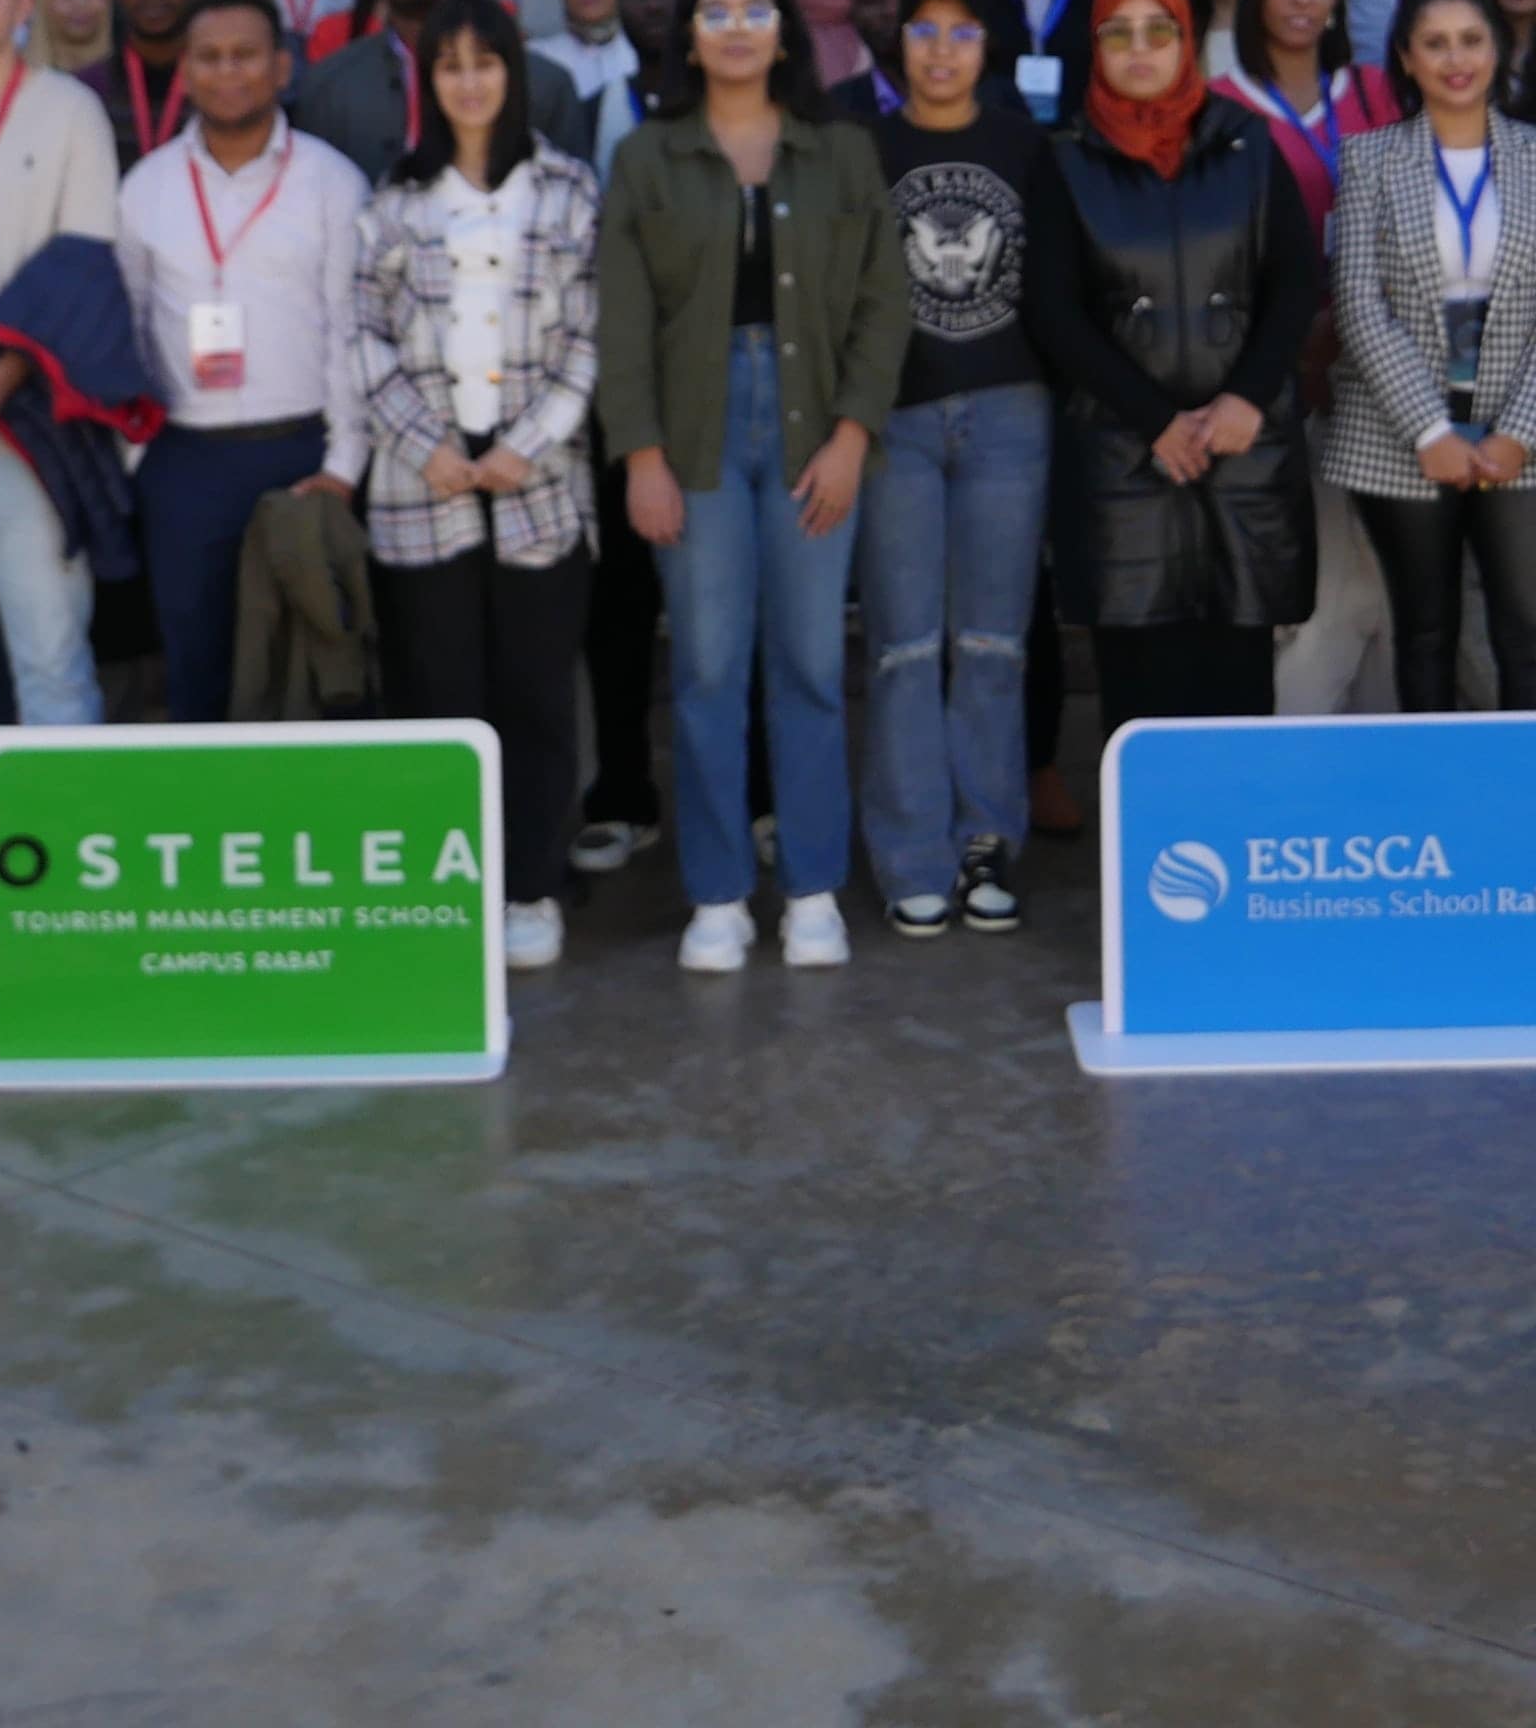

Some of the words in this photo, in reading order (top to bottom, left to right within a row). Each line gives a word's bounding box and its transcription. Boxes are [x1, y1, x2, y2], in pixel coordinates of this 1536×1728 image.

[1246, 834, 1452, 884] ESLSCA
[12, 910, 138, 934] TOURISM
[146, 907, 343, 931] MANAGEMENT
[355, 904, 471, 928] SCHOOL
[1248, 890, 1382, 920] Business
[1389, 886, 1491, 916] School
[140, 952, 246, 975] CAMPUS
[254, 950, 334, 973] RABAT
